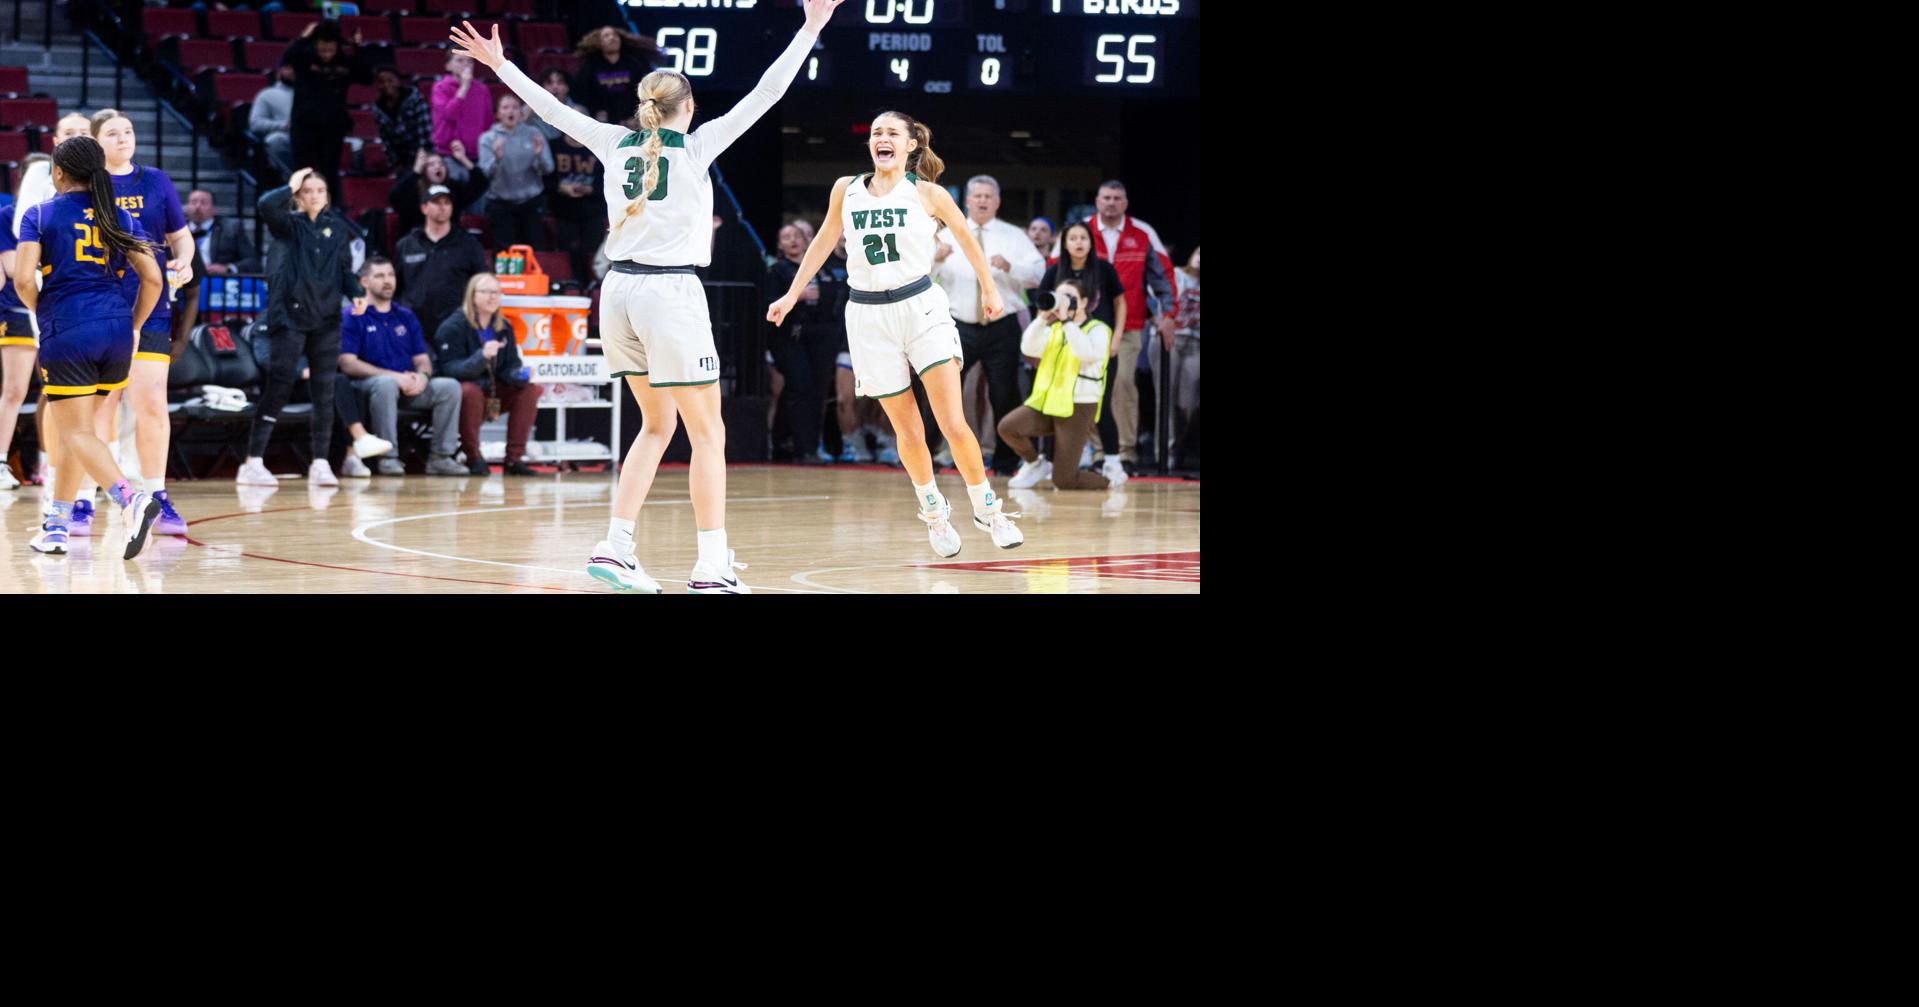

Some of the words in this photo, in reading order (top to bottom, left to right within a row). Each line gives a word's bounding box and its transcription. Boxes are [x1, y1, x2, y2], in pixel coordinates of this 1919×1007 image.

[656, 27, 718, 76] 58
[868, 33, 932, 51] PERIOD
[976, 34, 1006, 52] TOL
[808, 57, 819, 81] 1
[890, 58, 909, 82] 4
[1095, 34, 1157, 84] 55
[981, 58, 1001, 86] 0
[851, 208, 907, 230] WEST
[863, 233, 900, 266] 21
[538, 362, 598, 377] GATORADE
